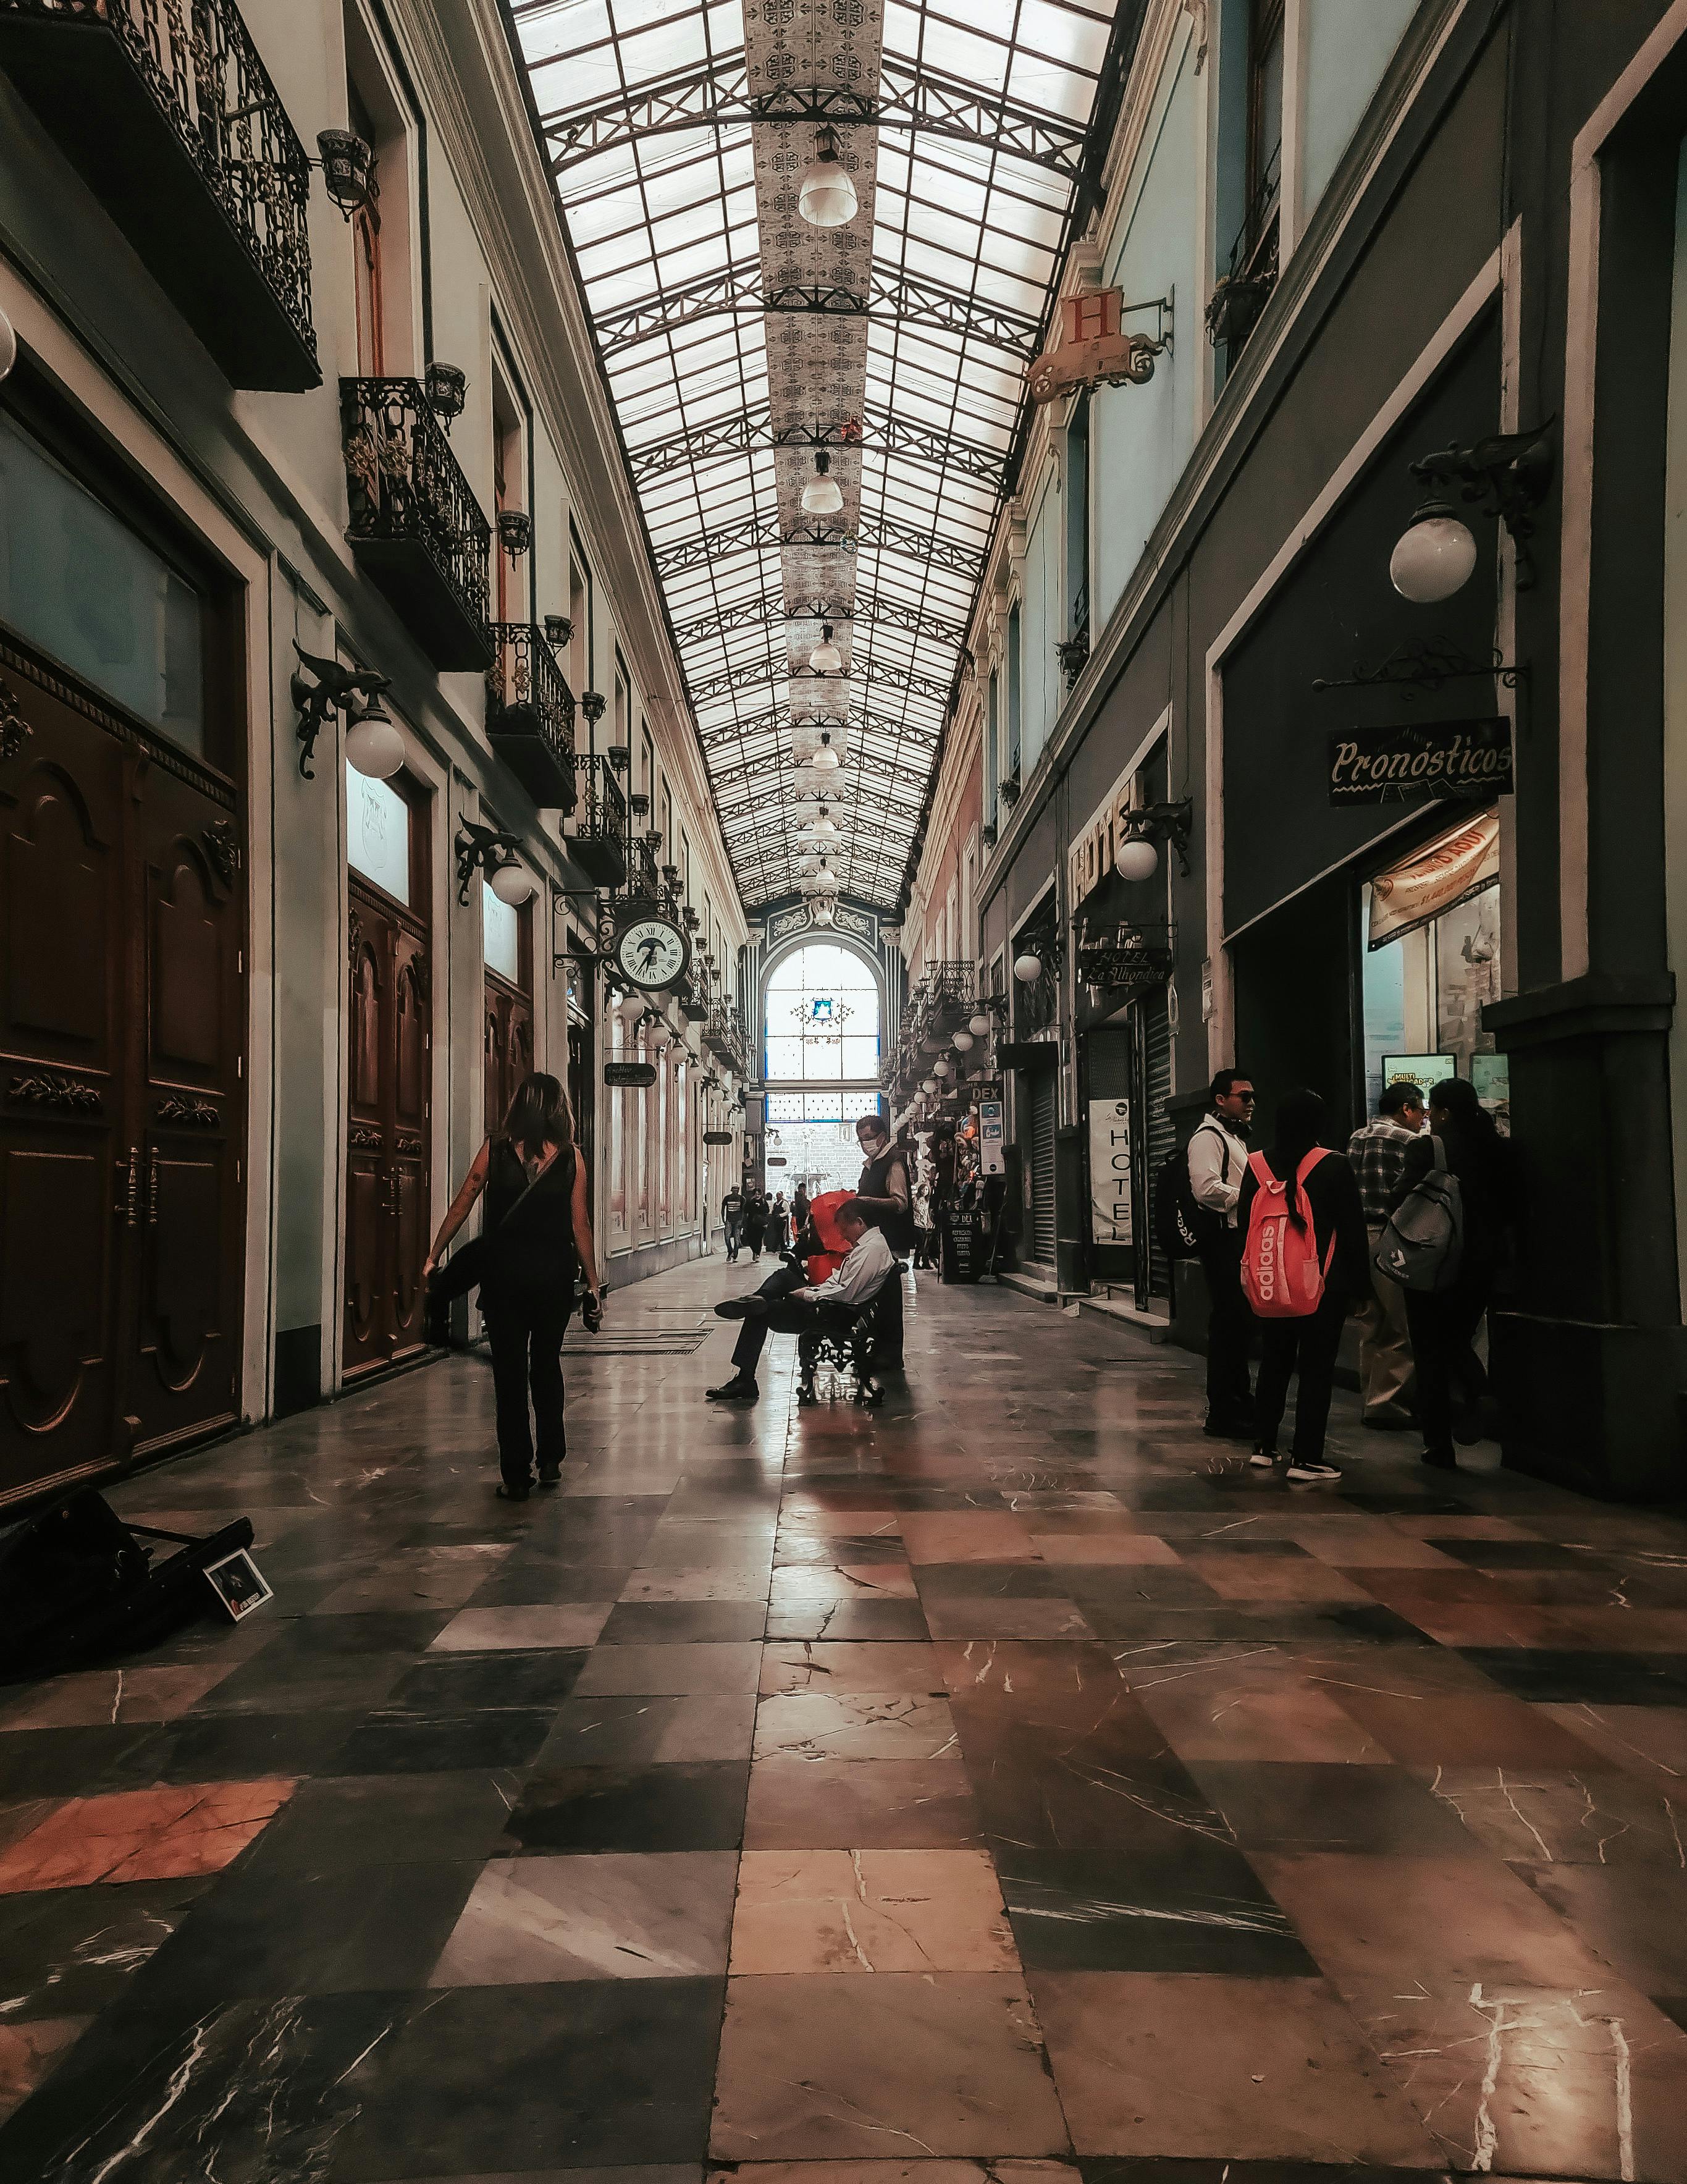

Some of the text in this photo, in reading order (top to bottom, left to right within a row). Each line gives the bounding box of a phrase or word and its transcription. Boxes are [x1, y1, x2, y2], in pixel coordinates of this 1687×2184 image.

[1067, 290, 1116, 345] H
[1332, 735, 1512, 783] Pronósticos
[1100, 950, 1148, 963] HOTEL
[972, 1088, 999, 1100] DEX
[1111, 1129, 1131, 1241] HOTEL
[1256, 1226, 1275, 1301] adidas
